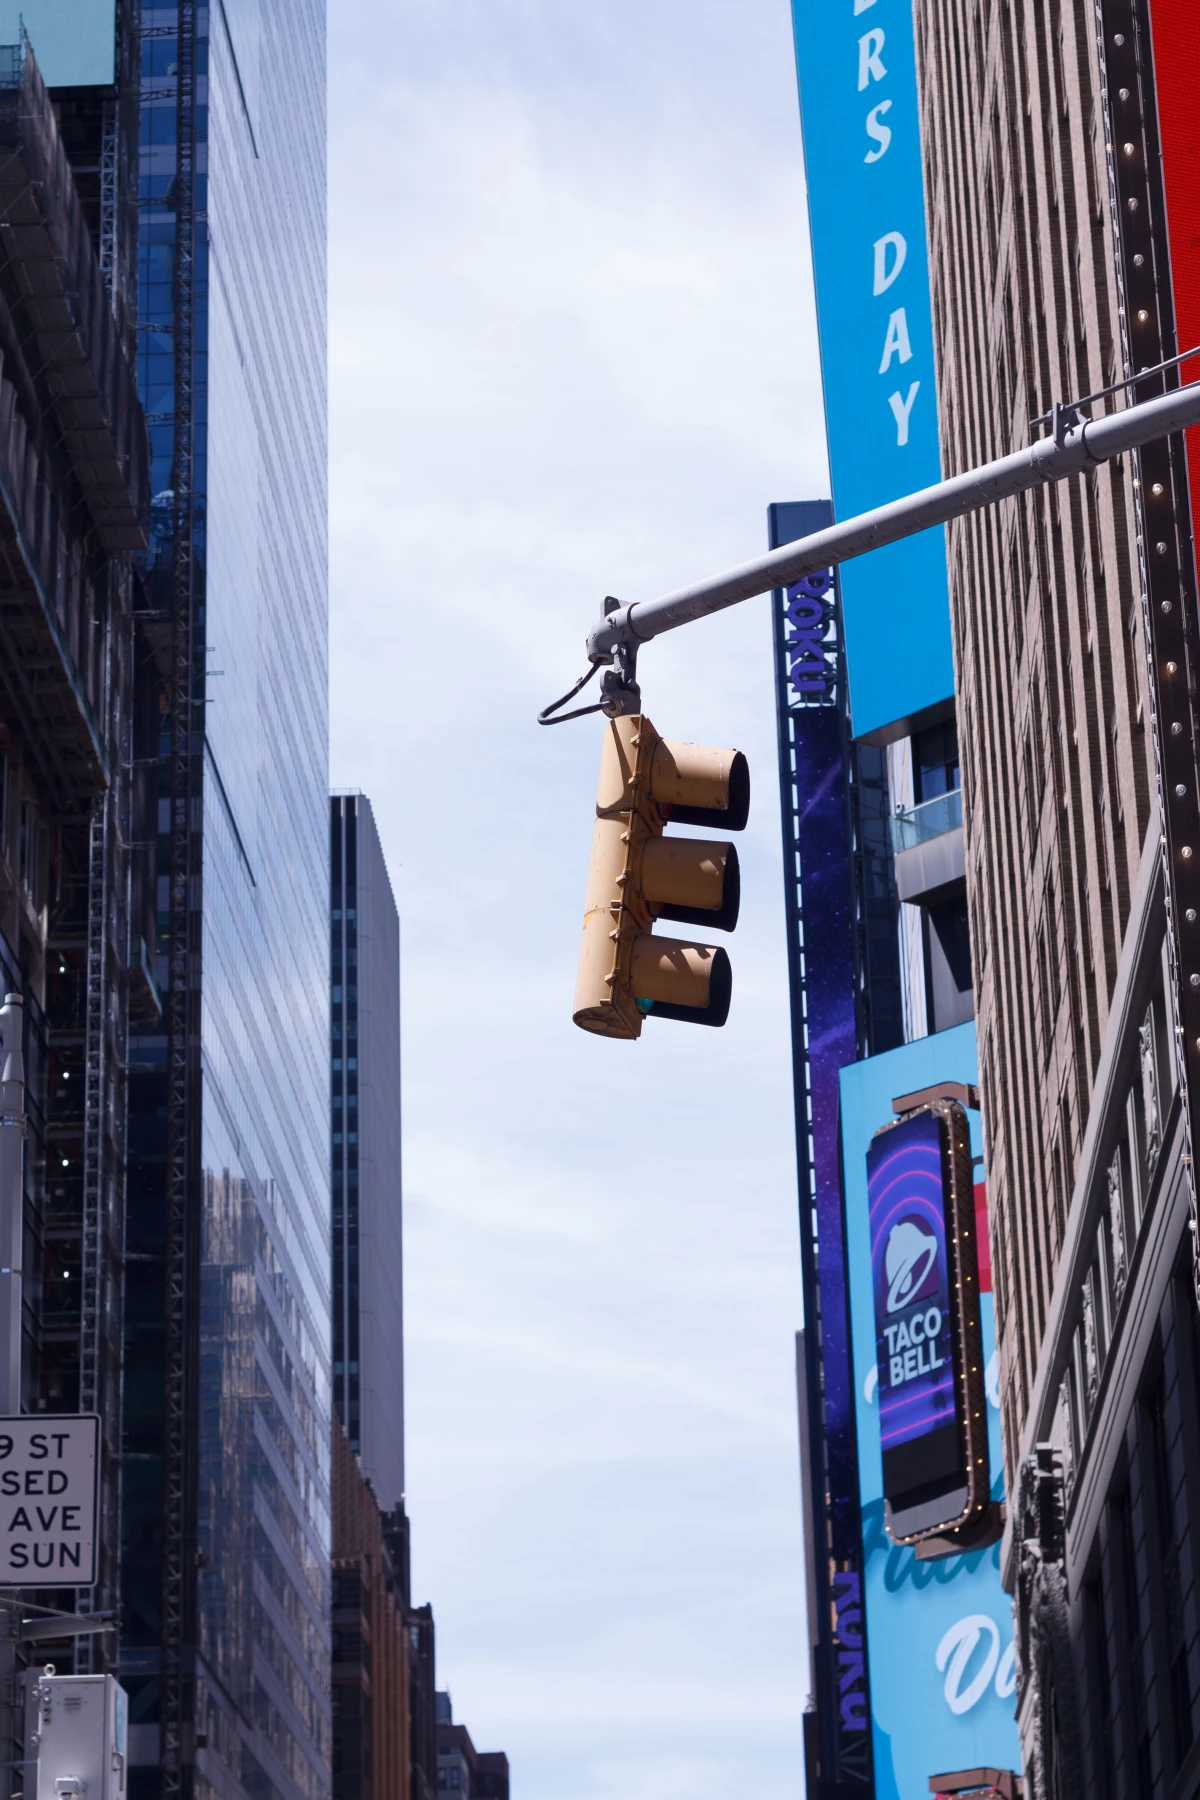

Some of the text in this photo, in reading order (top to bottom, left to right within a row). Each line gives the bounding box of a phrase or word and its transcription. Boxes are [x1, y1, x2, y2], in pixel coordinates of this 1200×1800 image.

[853, 0, 921, 447] RS DAY
[883, 1306, 942, 1356] TACO
[889, 1339, 946, 1388] BELL
[28, 1433, 70, 1460] ST
[0, 1469, 69, 1496] SED
[7, 1505, 81, 1532] AVE
[8, 1542, 81, 1569] SUN
